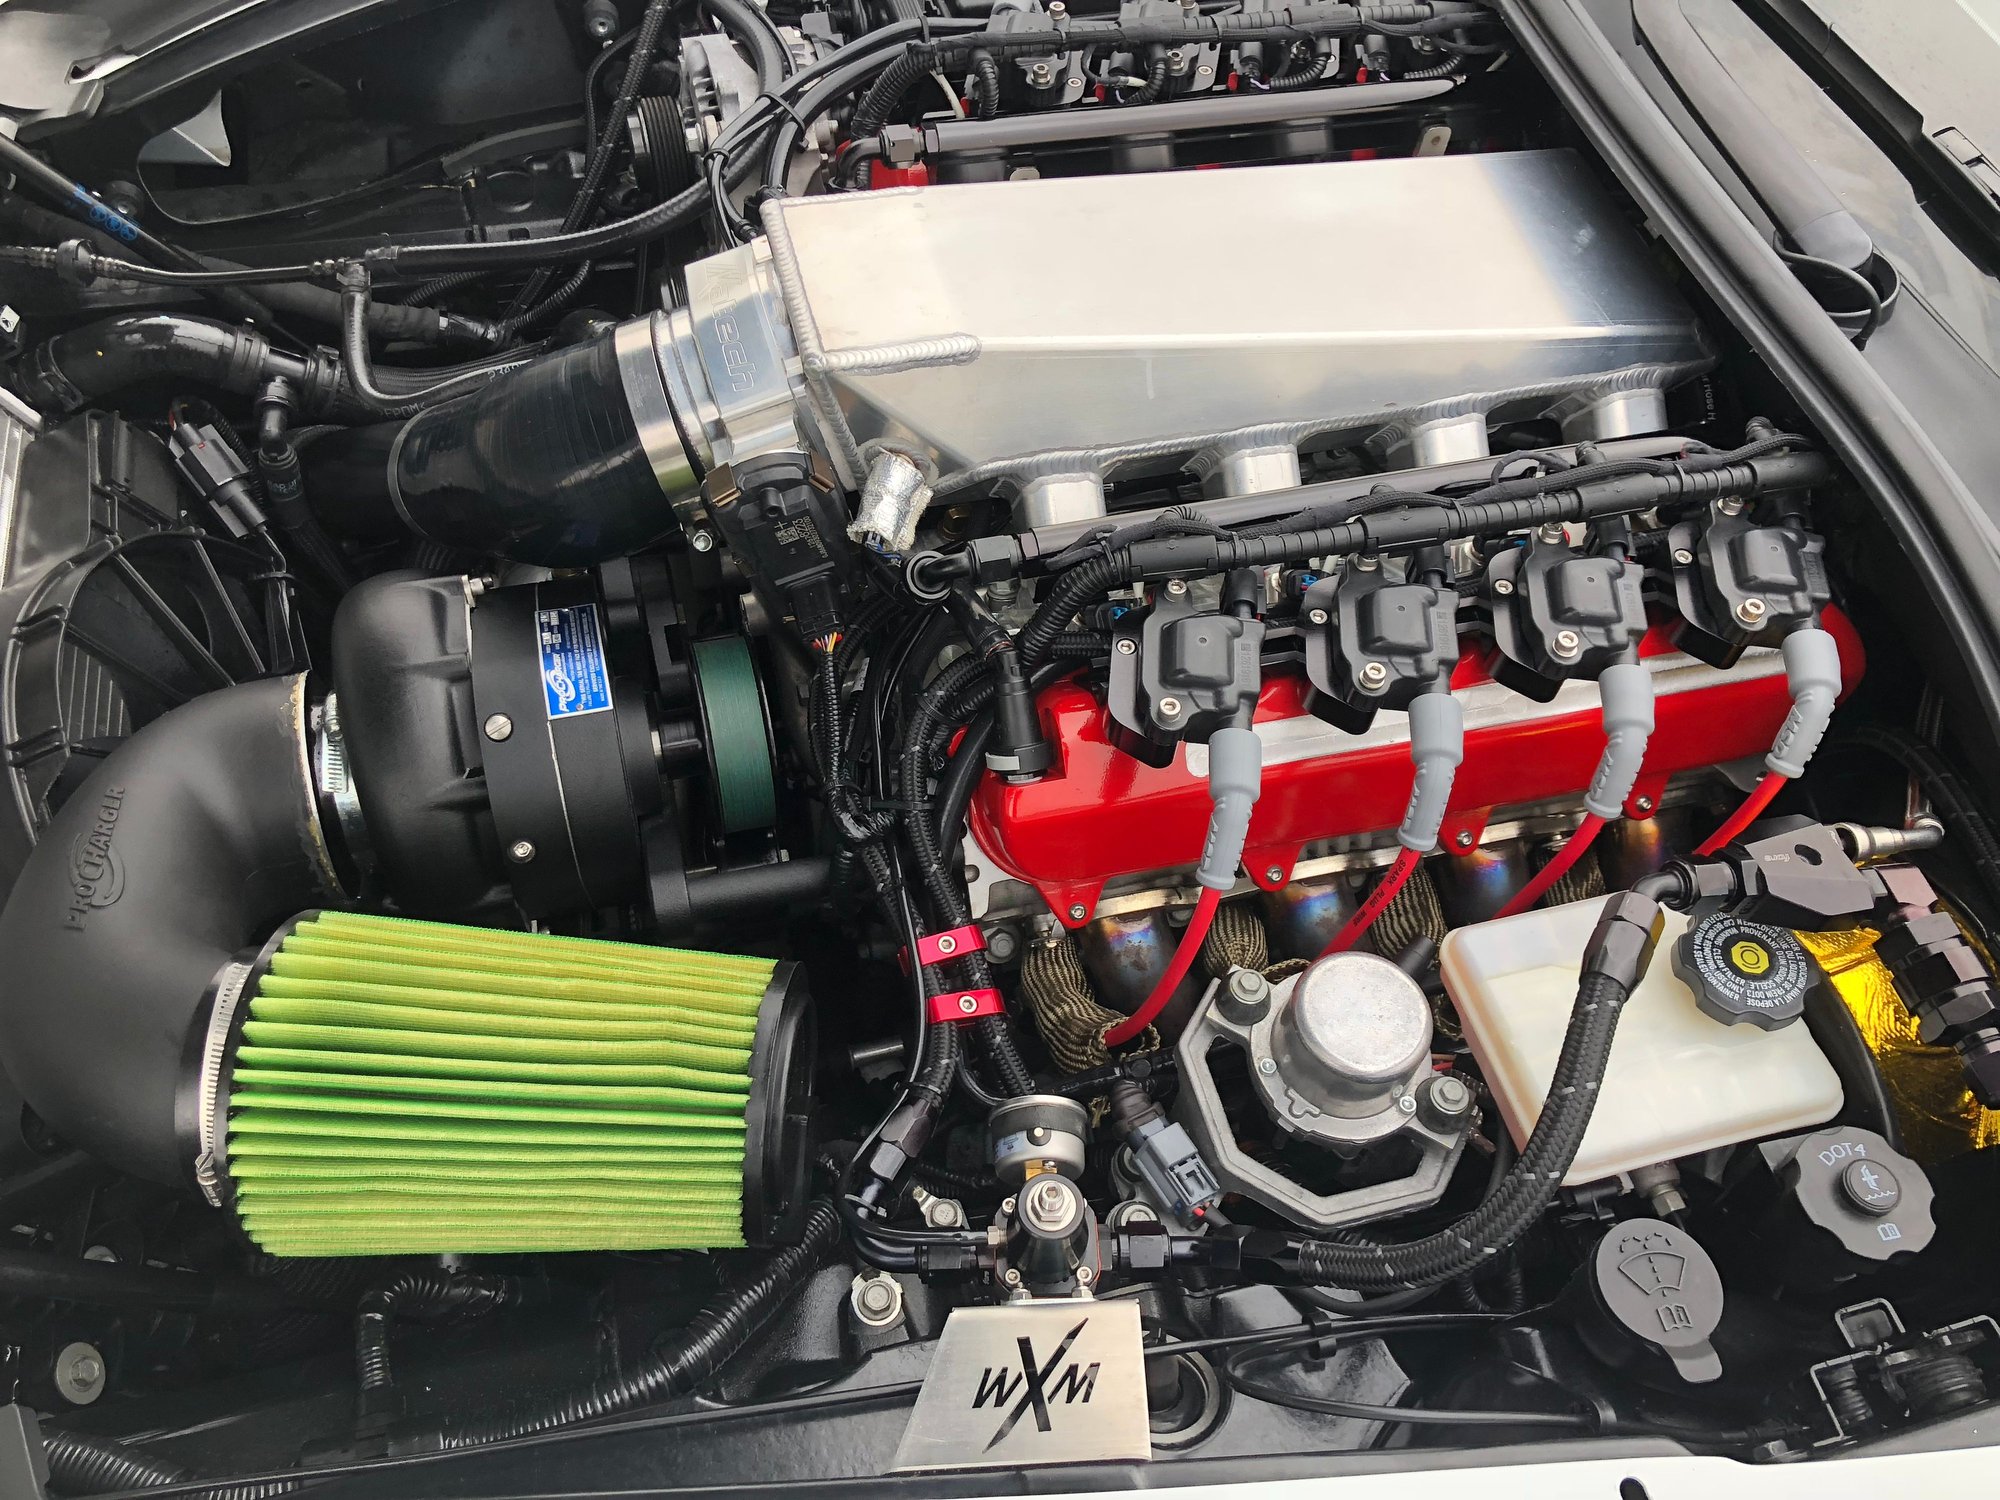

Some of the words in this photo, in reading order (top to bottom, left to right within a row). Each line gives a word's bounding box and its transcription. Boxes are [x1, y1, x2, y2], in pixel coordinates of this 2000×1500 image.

[697, 263, 756, 392] Katech
[551, 651, 570, 713] PROCHARGER
[64, 786, 125, 932] PROCHARGER
[1386, 859, 1407, 887] SPARK
[1369, 888, 1386, 909] PLUG
[1740, 926, 1781, 950] PROVENANT
[1693, 950, 1709, 973] SEALED
[1785, 950, 1796, 959] DU
[1795, 952, 1806, 960] LE
[1713, 948, 1727, 968] CLEAN
[1722, 967, 1746, 987] FILLER
[1795, 961, 1808, 990] BOUCHON
[1713, 970, 1729, 984] USE
[1726, 980, 1745, 994] ONLY
[1746, 989, 1766, 999] DOT3
[1773, 997, 1785, 1007] LA
